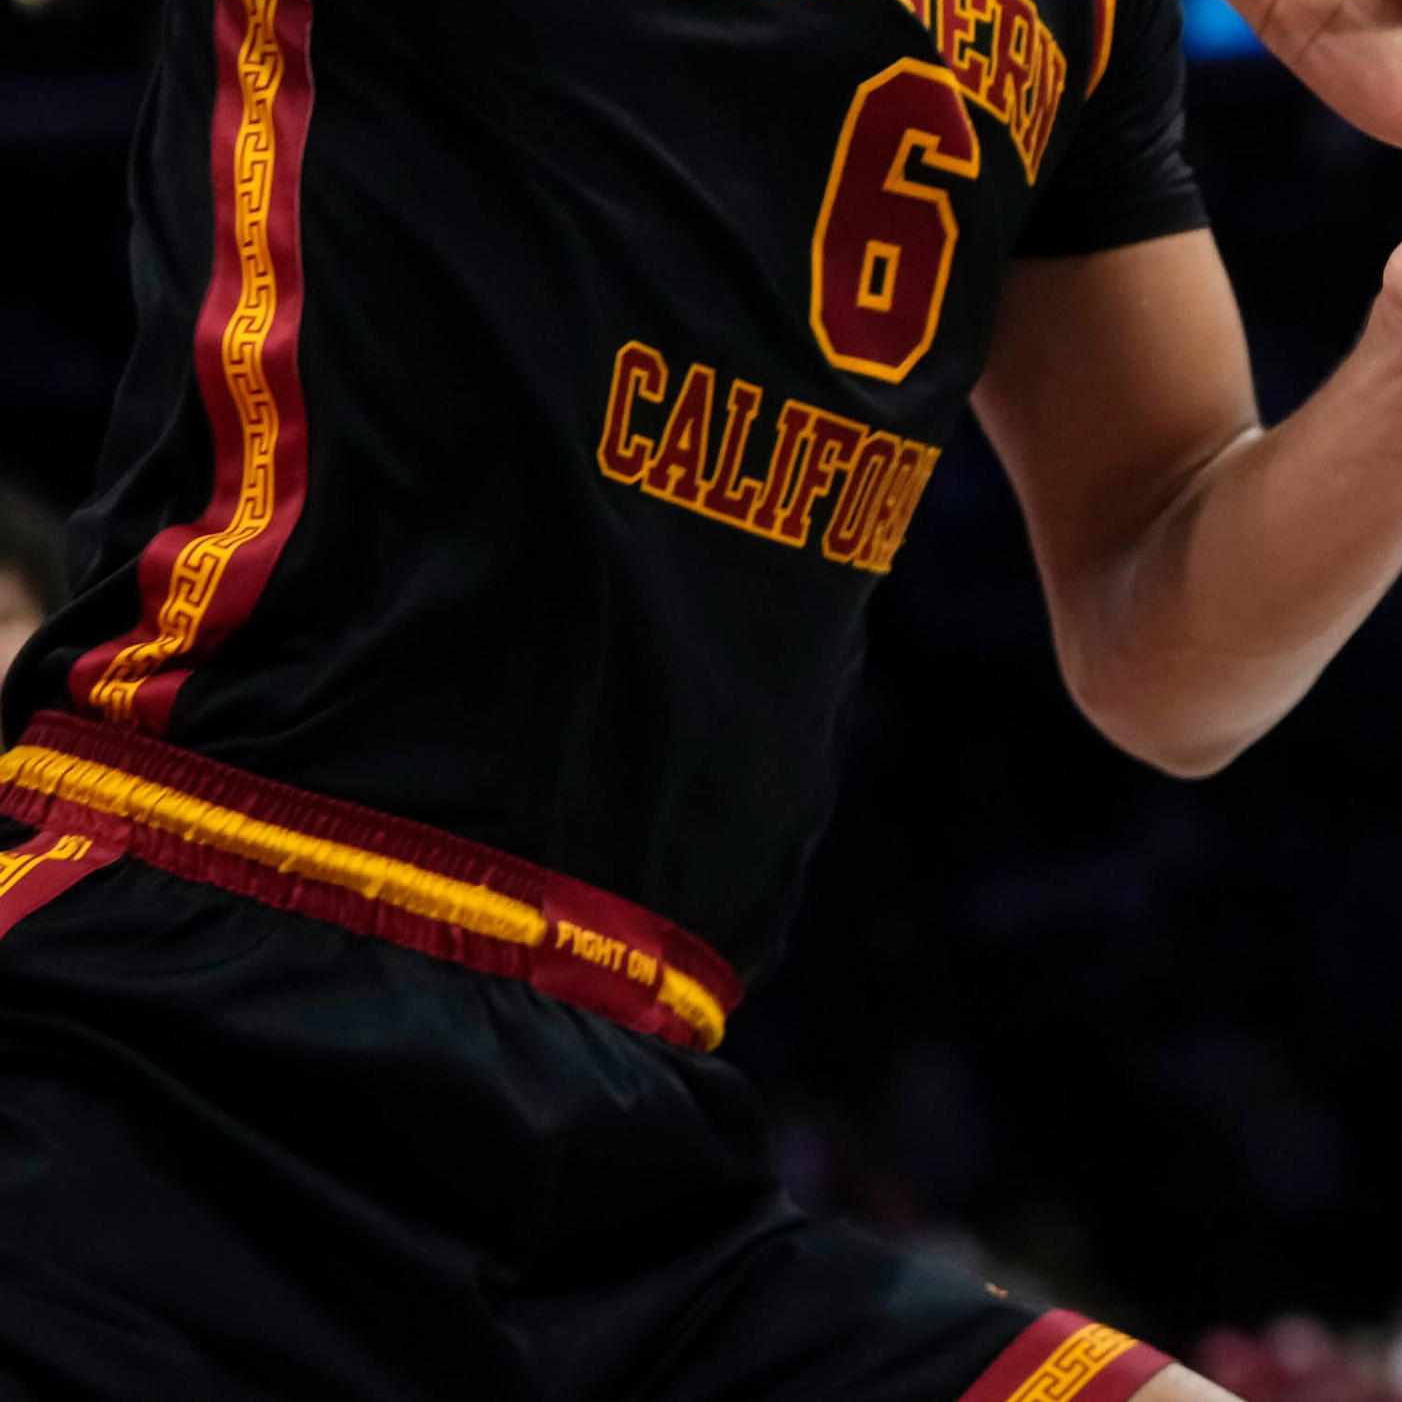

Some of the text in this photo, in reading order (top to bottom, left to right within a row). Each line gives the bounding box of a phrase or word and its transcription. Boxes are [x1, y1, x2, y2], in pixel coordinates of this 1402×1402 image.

[810, 56, 980, 382] 6
[555, 920, 658, 986] FIGHT ON
